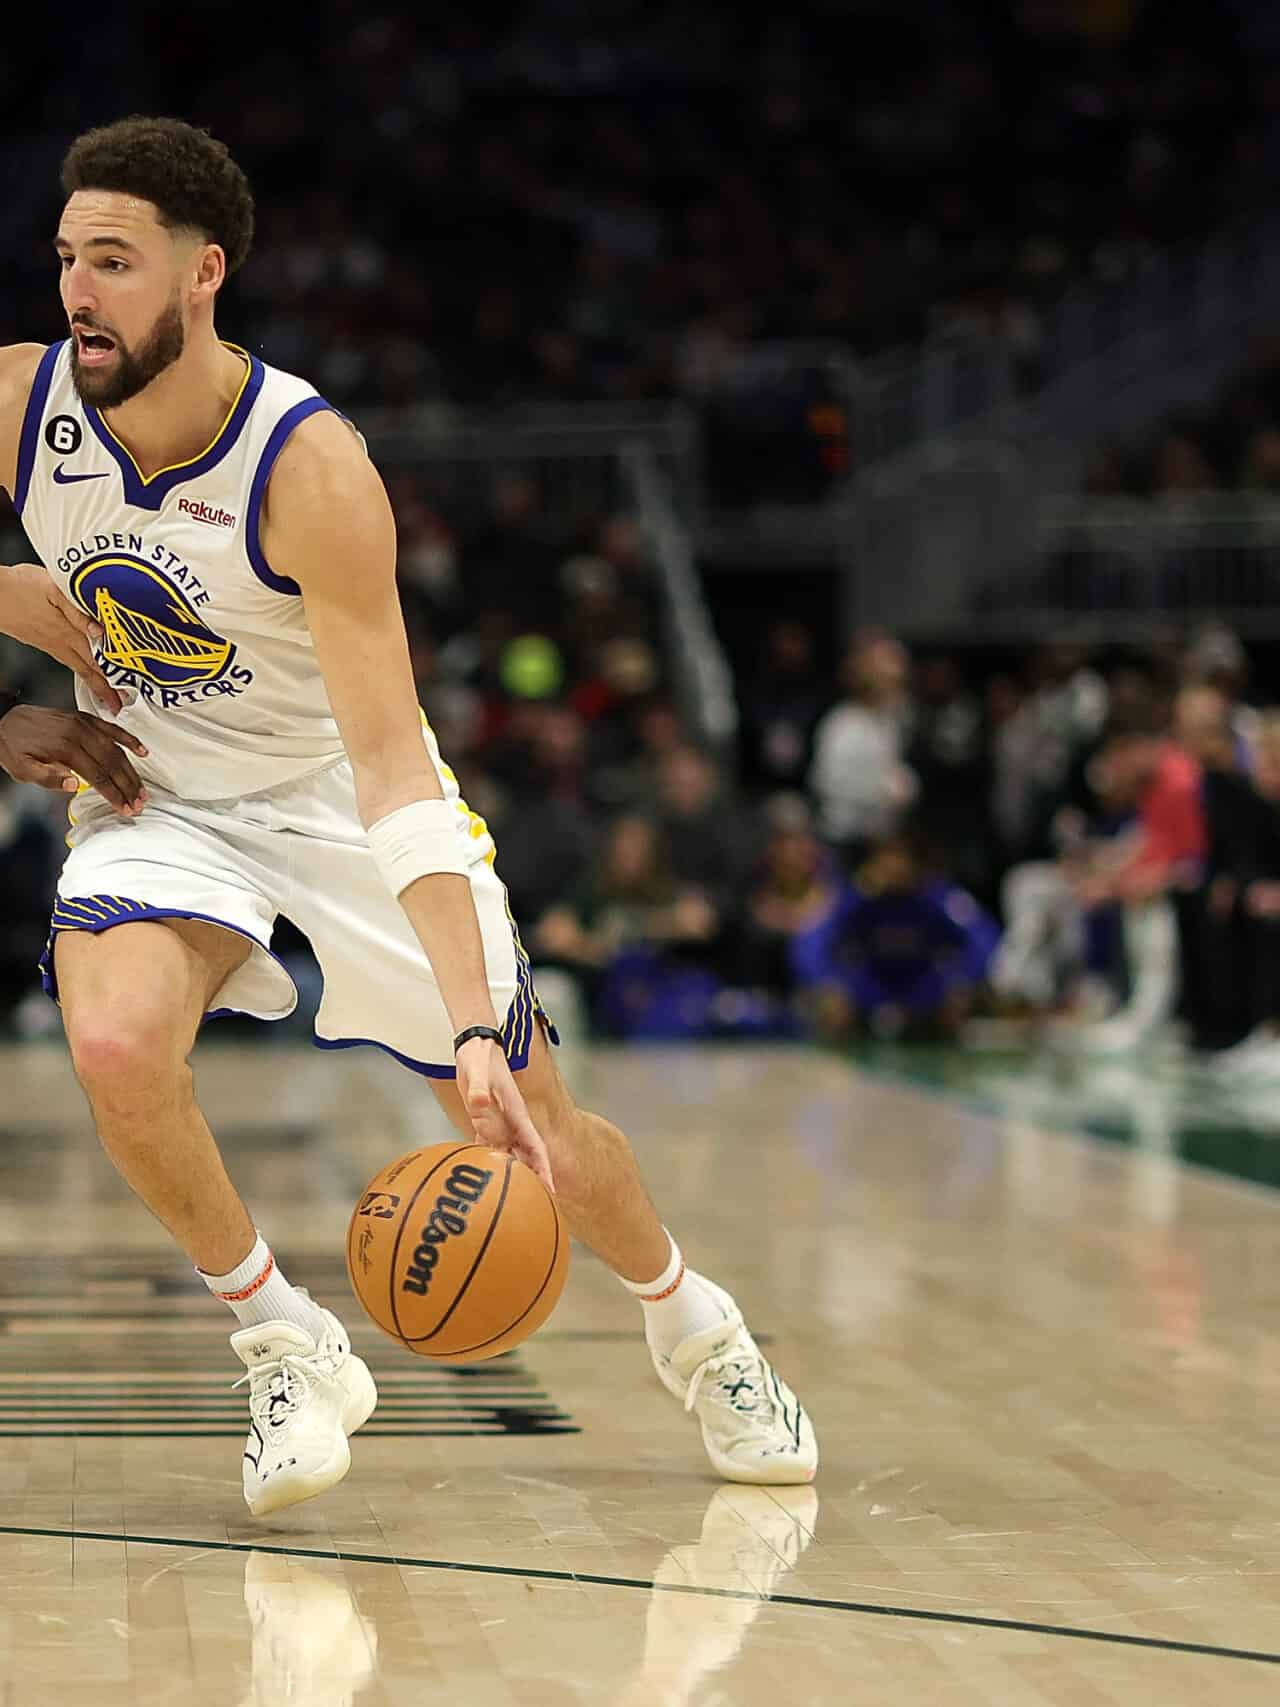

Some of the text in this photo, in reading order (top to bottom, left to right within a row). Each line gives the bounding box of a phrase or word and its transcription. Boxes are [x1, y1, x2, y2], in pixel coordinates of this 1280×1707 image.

[54, 419, 75, 450] 6
[178, 498, 236, 528] Rakuten
[57, 533, 210, 607] GOLDEN STATE
[94, 649, 254, 708] WARRIORS
[402, 1163, 494, 1296] Wilson
